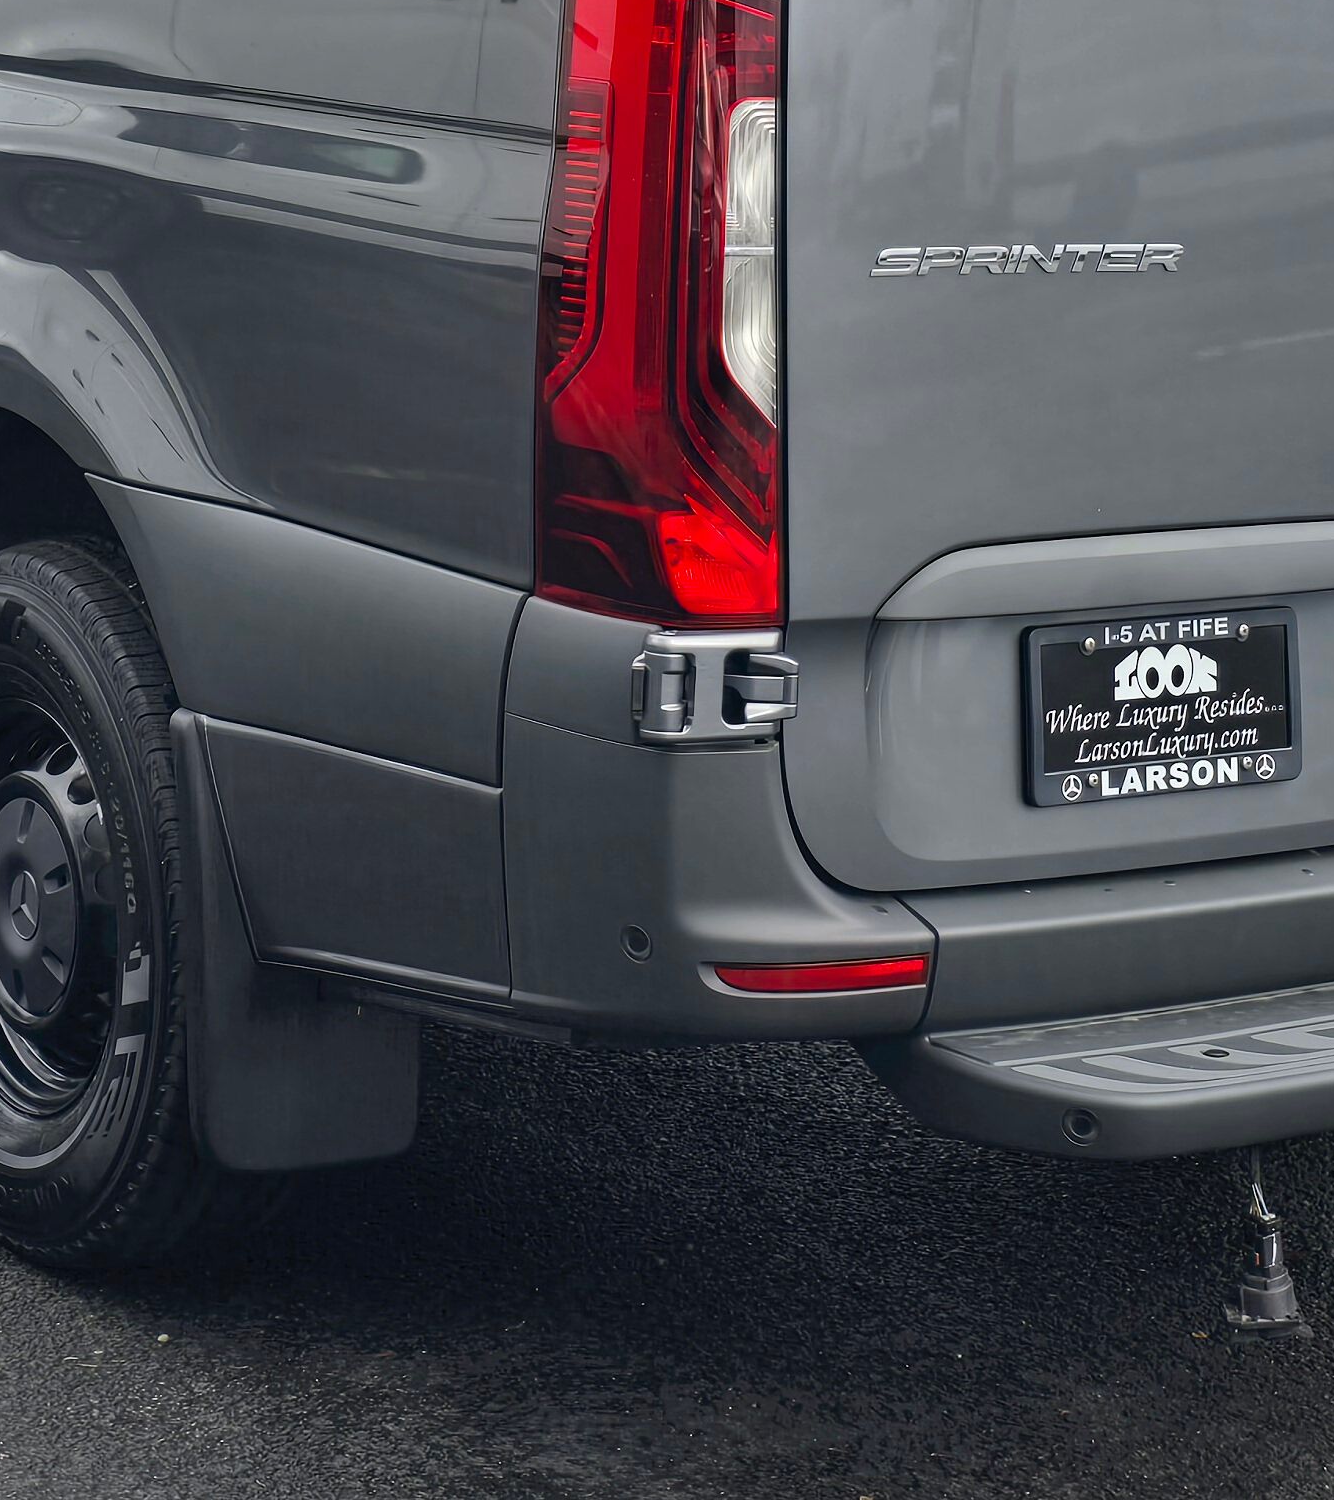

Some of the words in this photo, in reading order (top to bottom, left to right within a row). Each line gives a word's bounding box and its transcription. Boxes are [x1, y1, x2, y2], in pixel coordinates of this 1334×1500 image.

[870, 244, 1185, 277] SPRINTER
[1104, 624, 1132, 645] I-5
[1139, 622, 1170, 642] AT
[1178, 617, 1229, 639] FIFE
[1046, 704, 1110, 734] Where
[1116, 703, 1188, 732] Luxury
[1075, 727, 1259, 763] LarsonLuxury.com
[1101, 757, 1239, 797] LARSON
